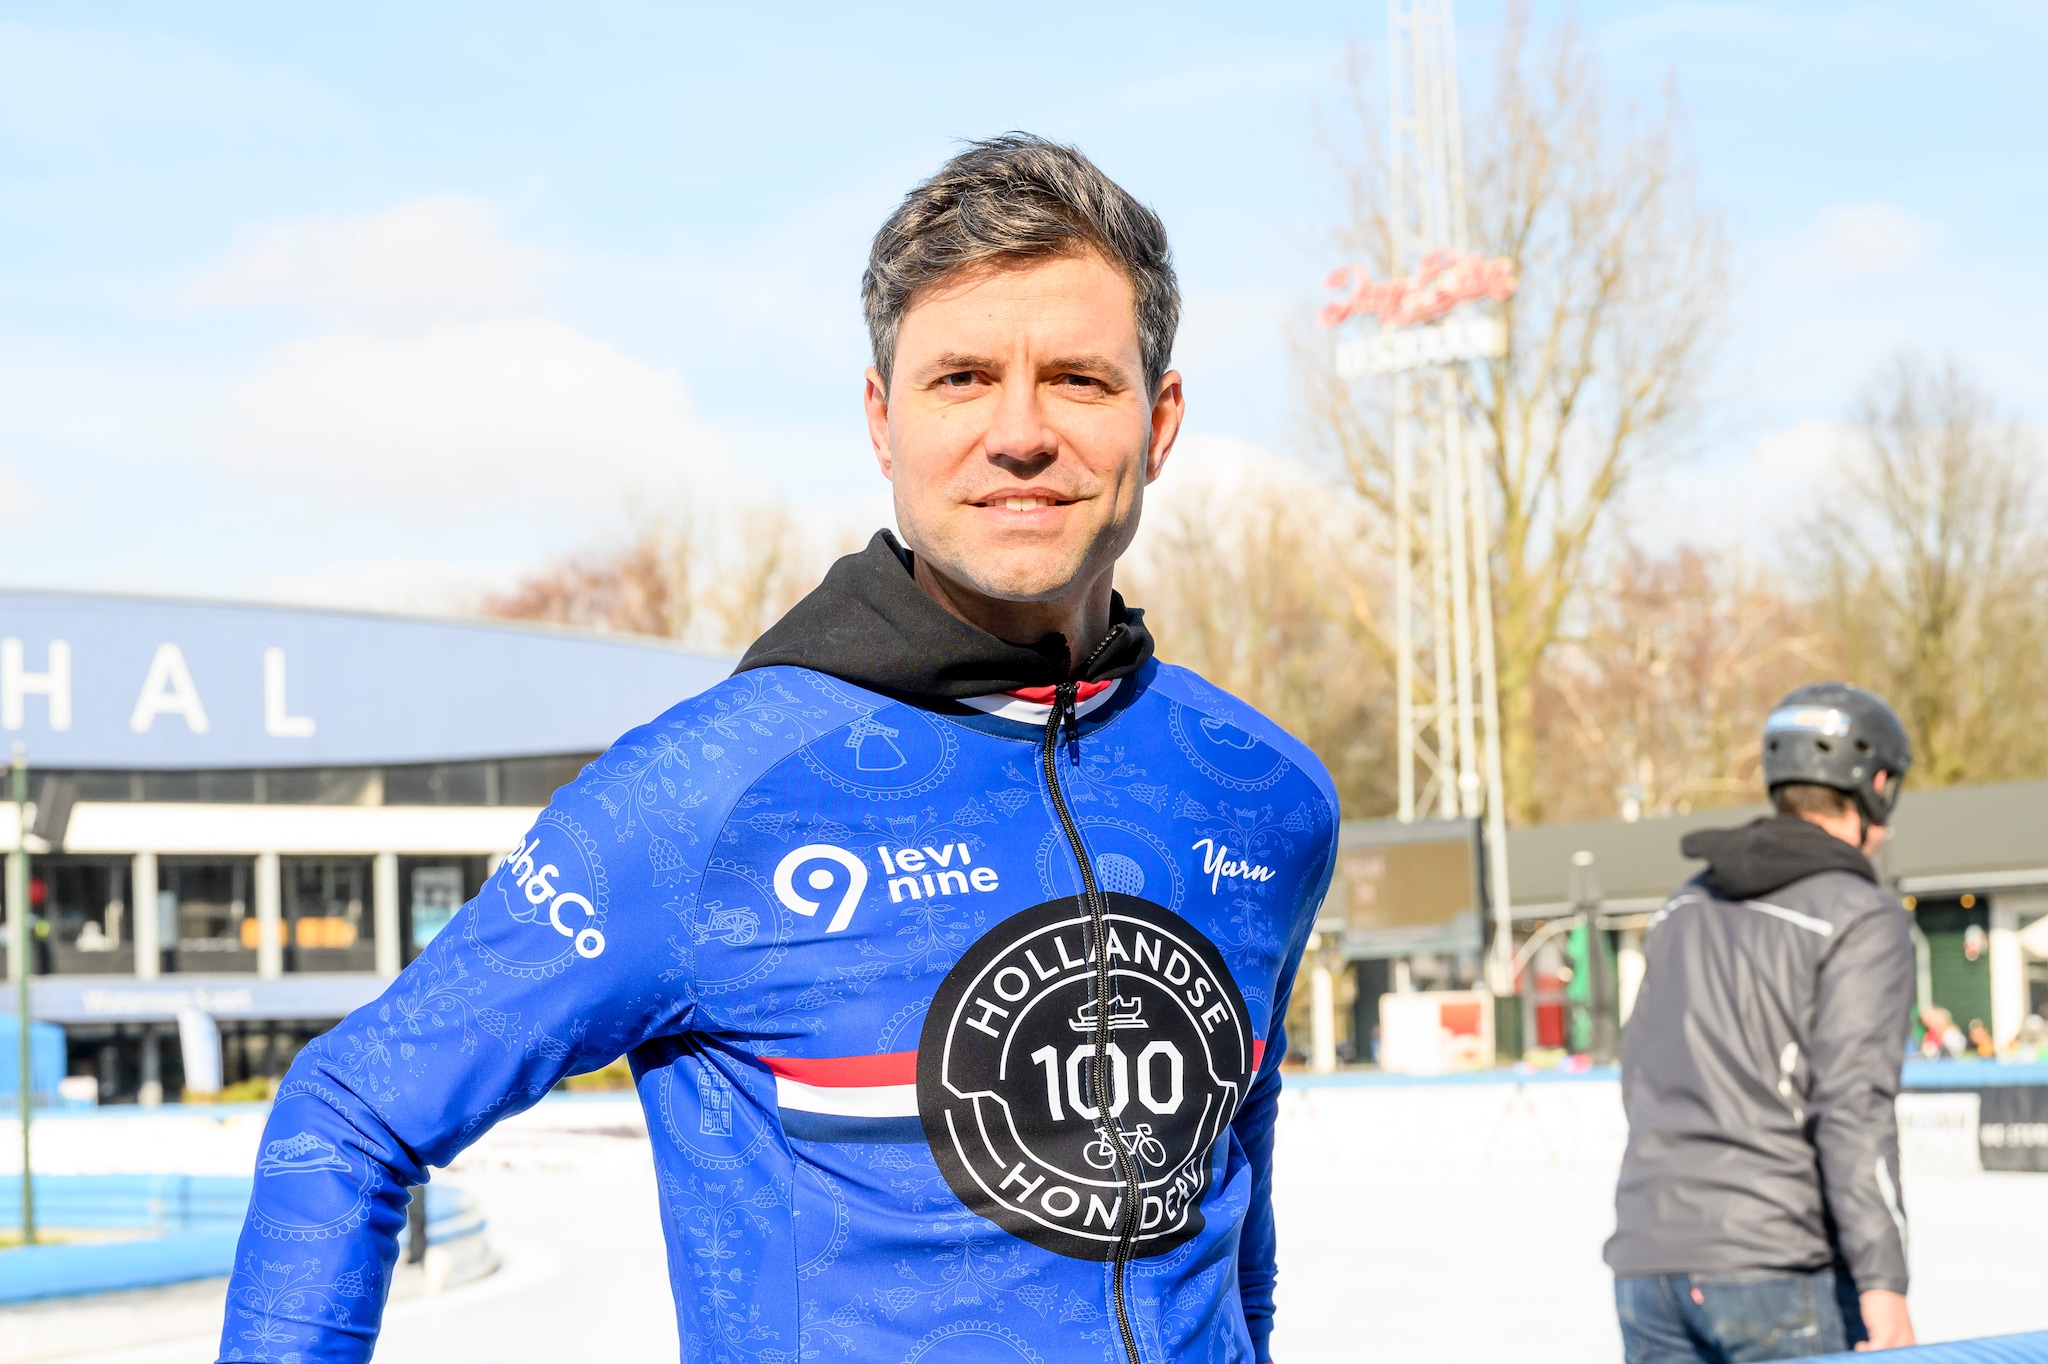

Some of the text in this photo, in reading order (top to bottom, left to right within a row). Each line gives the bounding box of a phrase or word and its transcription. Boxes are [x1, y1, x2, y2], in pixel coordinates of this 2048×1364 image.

[877, 842, 972, 875] levi
[888, 866, 999, 904] nine
[1191, 838, 1276, 896] Yarn
[965, 927, 1230, 1039] HOLLANDSE
[1030, 1040, 1184, 1121] 100
